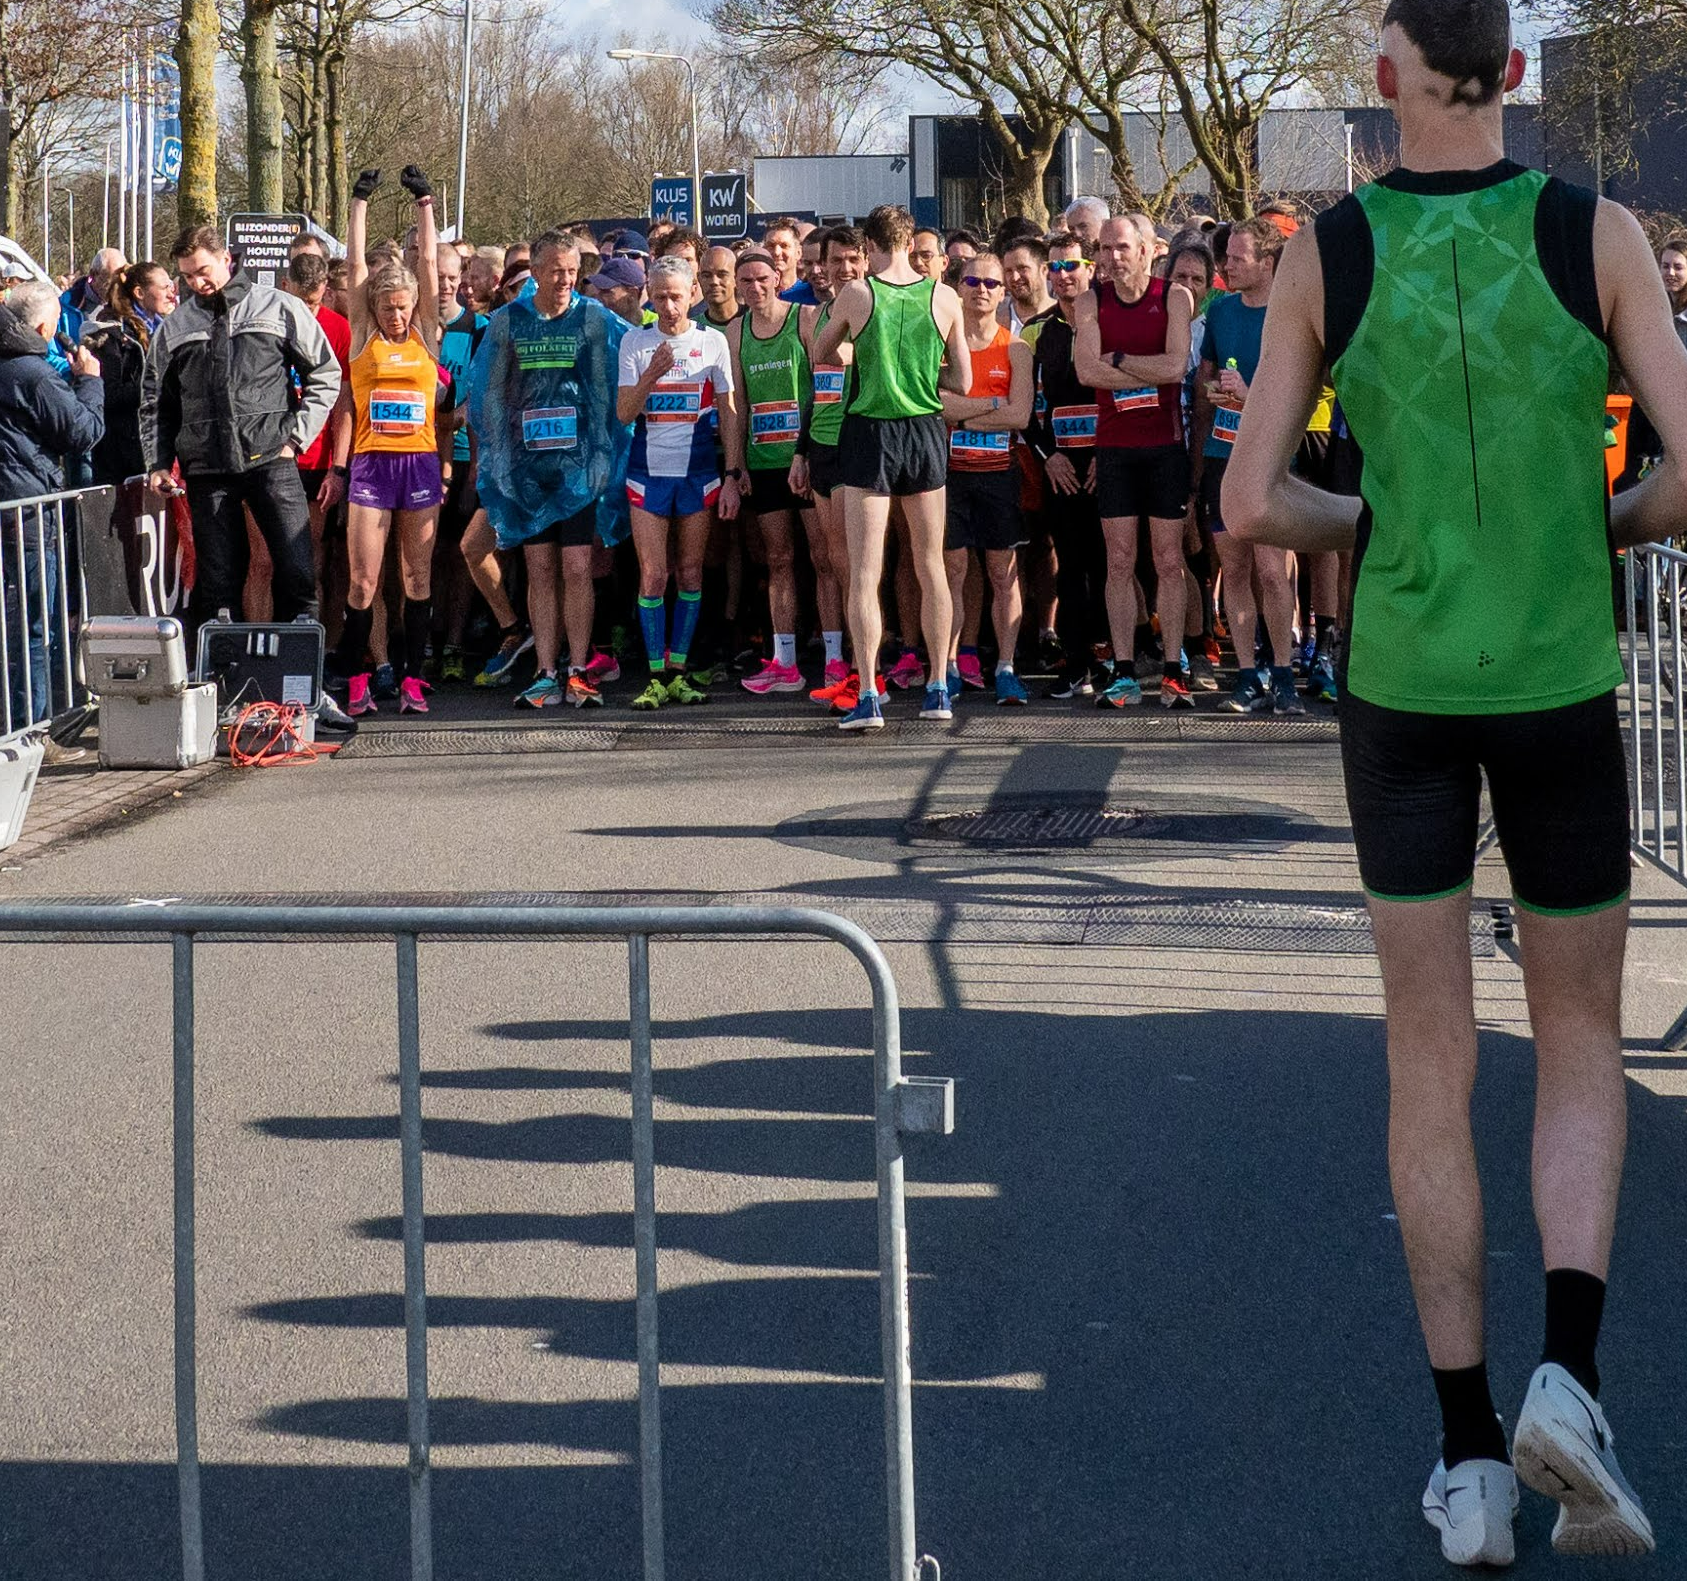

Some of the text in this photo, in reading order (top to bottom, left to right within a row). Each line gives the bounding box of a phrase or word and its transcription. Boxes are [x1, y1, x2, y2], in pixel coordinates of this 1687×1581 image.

[655, 187, 688, 204] KLUS
[246, 247, 288, 257] HOUTEN
[243, 258, 281, 268] LOEREN
[646, 396, 685, 411] 1222
[372, 404, 412, 419] 1544
[525, 421, 563, 438] 1216
[753, 414, 785, 432] 1528
[1059, 419, 1088, 434] 344
[959, 432, 987, 446] 181
[135, 510, 190, 617] RU
